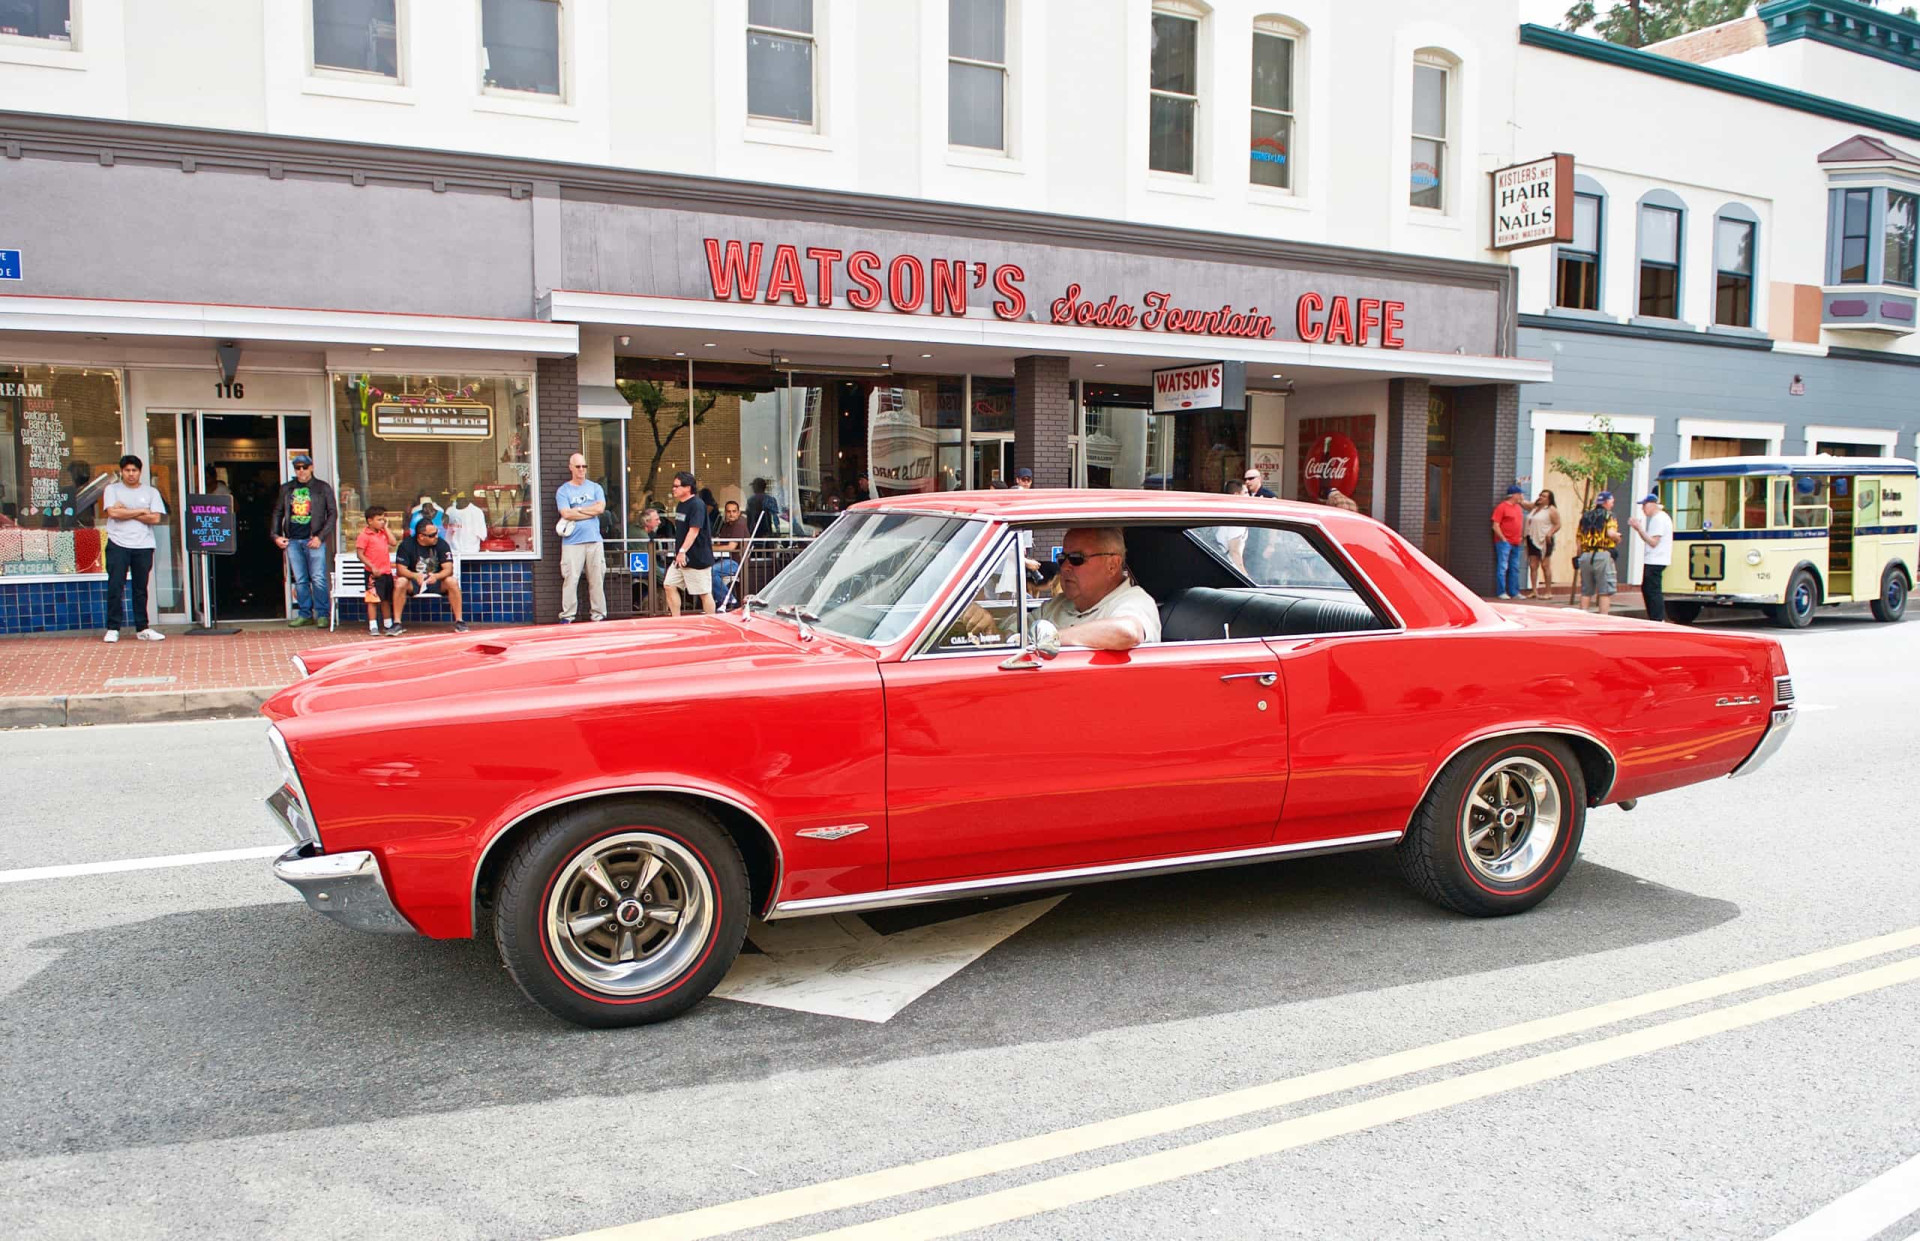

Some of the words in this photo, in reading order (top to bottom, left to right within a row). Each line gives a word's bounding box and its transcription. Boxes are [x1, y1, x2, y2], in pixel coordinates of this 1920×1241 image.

[1502, 181, 1549, 207] HAIR
[1521, 201, 1528, 213] &
[1499, 206, 1552, 232] NAILS
[703, 238, 1026, 320] WATSON'S
[1050, 283, 1138, 327] Soda
[1140, 291, 1277, 339] Fountain
[1296, 292, 1404, 350] CAFE
[1156, 367, 1220, 393] WATSON'S
[214, 382, 244, 399] 116
[409, 407, 457, 415] WATSON'S
[1305, 457, 1350, 480] Coca-Cola
[191, 504, 228, 514] WELCOME
[195, 515, 221, 523] PLEASE
[198, 535, 226, 543] SEATED
[210, 528, 220, 536] TO
[222, 529, 232, 537] BE
[26, 563, 54, 573] CREAM
[1756, 572, 1771, 580] 126
